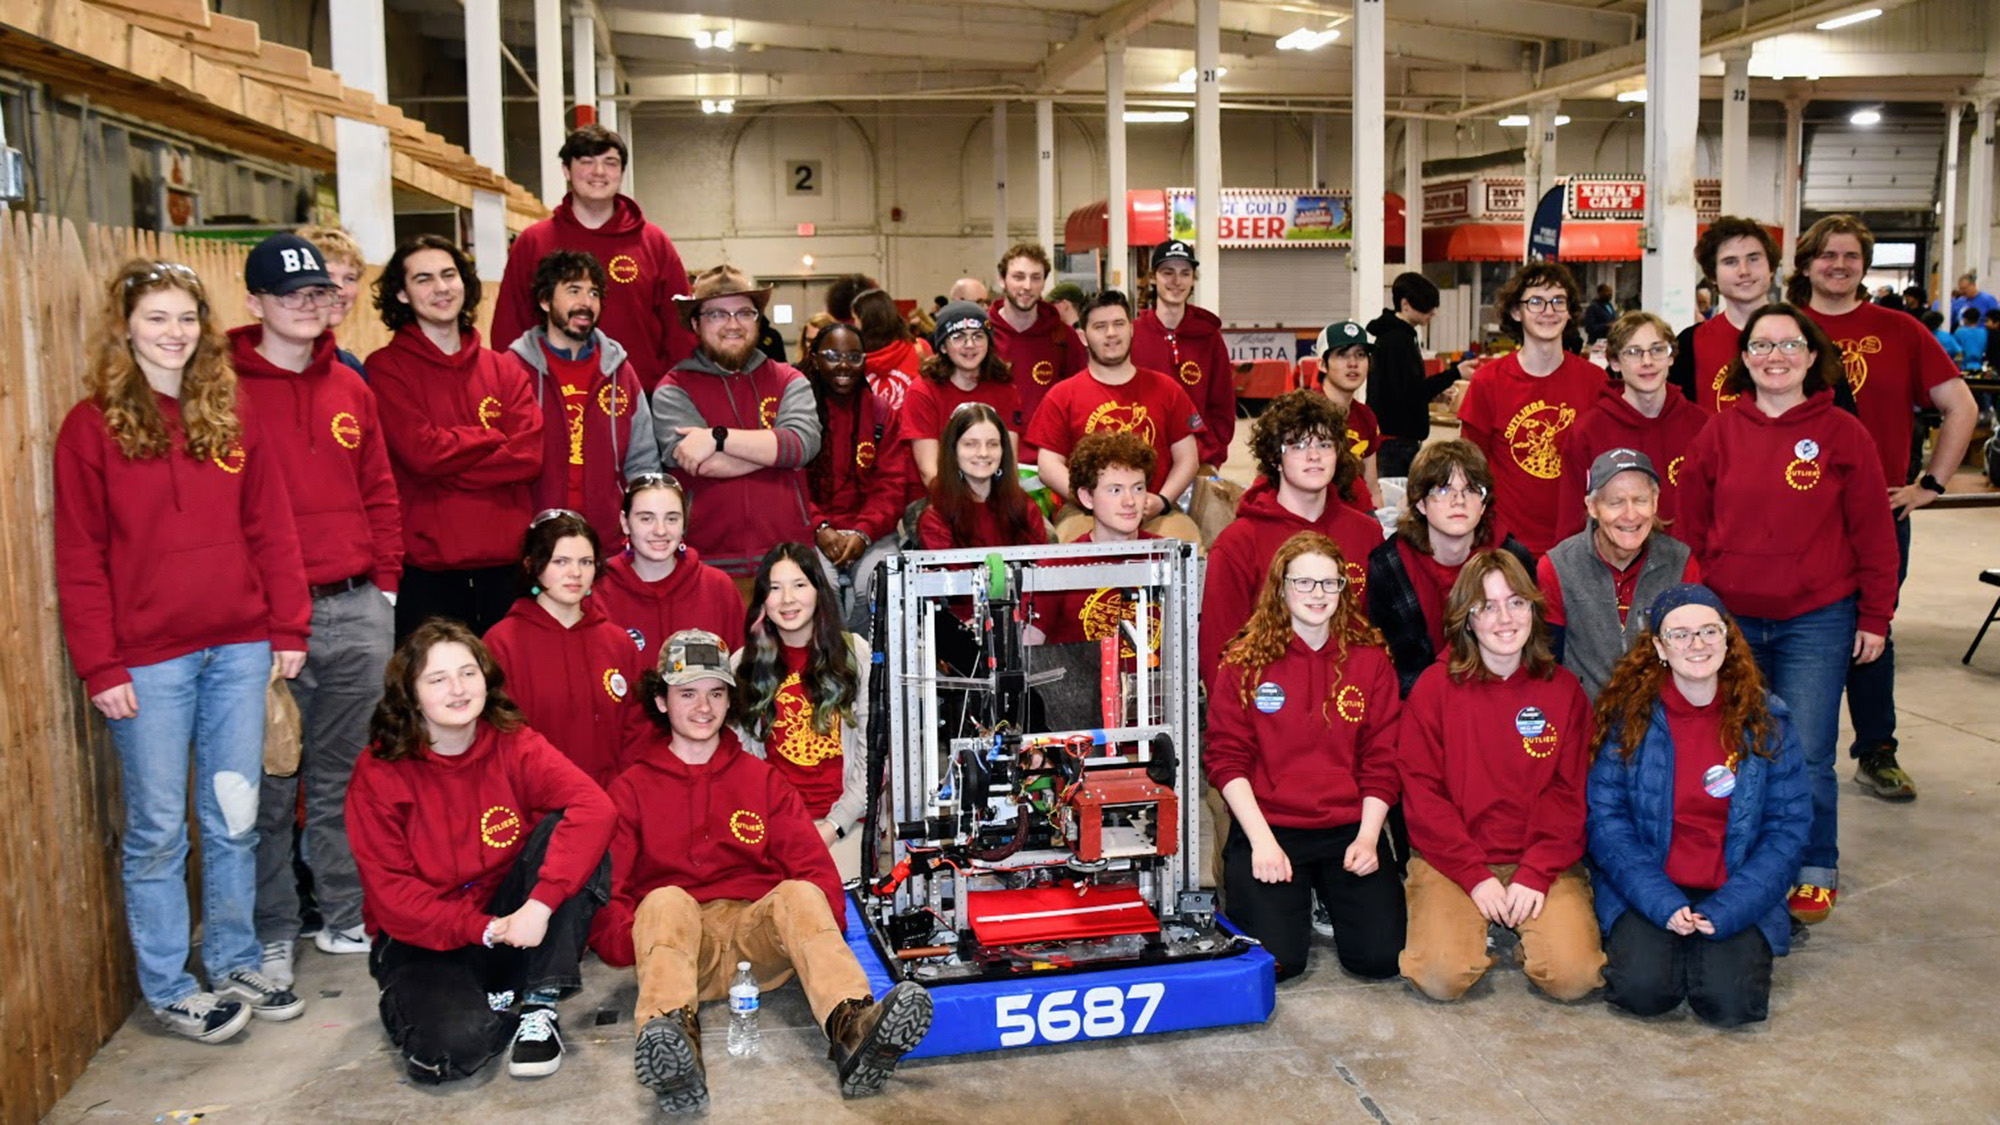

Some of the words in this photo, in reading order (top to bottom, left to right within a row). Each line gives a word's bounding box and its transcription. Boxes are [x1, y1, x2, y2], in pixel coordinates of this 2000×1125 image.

[1204, 70, 1215, 82] 21
[795, 165, 813, 191] 2
[1580, 184, 1641, 198] XENA'S
[1246, 202, 1288, 215] COLD
[1588, 197, 1633, 209] CAFE
[1218, 216, 1286, 239] BEER
[281, 247, 321, 273] BA
[1504, 400, 1546, 439] OUTLIERS
[996, 982, 1166, 1047] 5687
